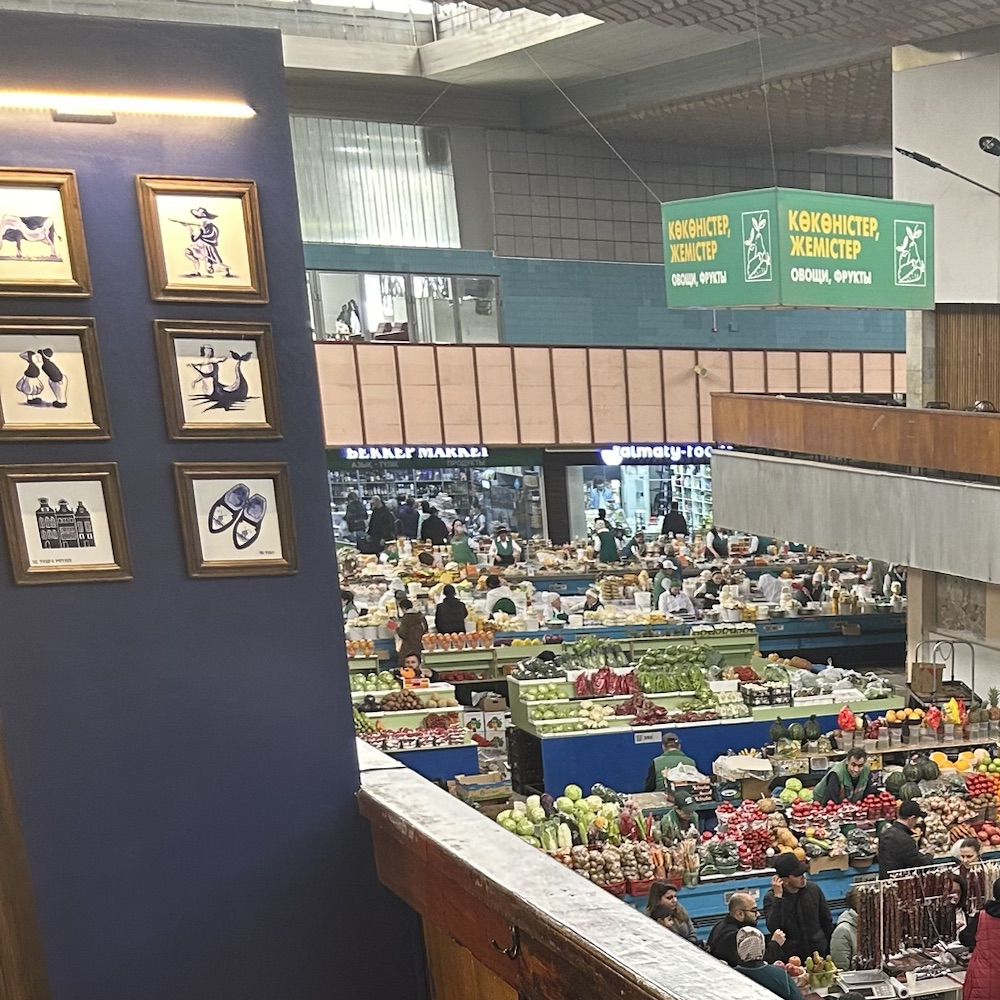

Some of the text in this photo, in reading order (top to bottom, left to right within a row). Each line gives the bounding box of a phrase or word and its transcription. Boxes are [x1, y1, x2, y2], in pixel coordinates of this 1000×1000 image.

[668, 214, 731, 241] КӨКӨНІСТЕР,
[788, 209, 880, 241] КӨКӨНІСТЕР,
[670, 240, 718, 264] ЖЕМІСТЕР
[789, 235, 862, 260] ЖЕМІСТЕР
[671, 271, 728, 288] ОВОЩИ, ФРУКТЫ
[790, 267, 872, 285] ОВОЩИ, ФРУКТЫ
